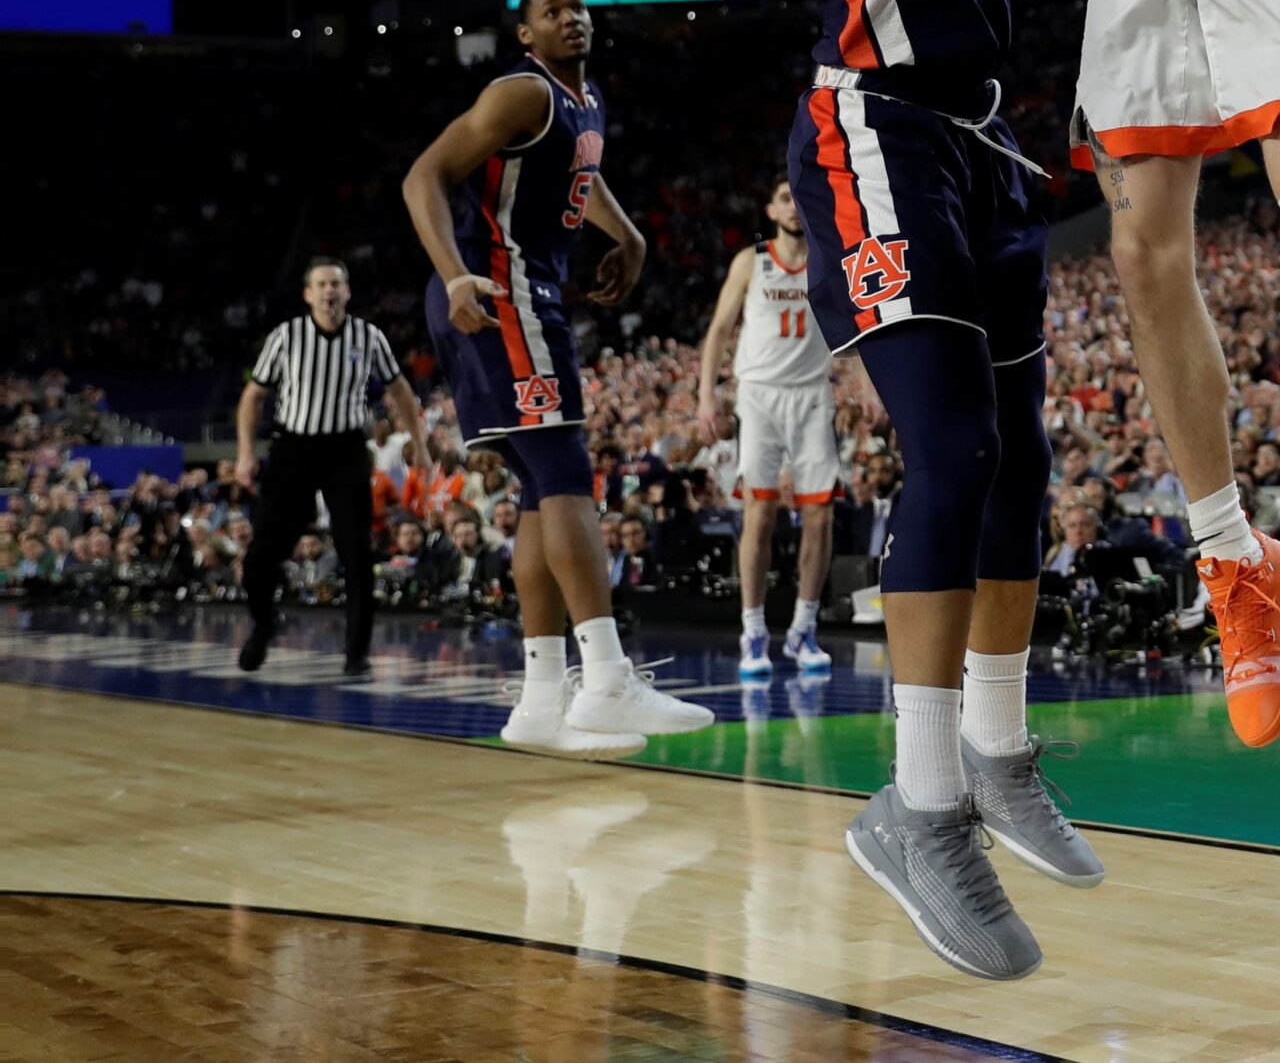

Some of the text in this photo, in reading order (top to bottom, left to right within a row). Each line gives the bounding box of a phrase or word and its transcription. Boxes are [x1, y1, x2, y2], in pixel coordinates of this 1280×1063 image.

[562, 171, 593, 229] 5
[763, 287, 810, 301] VIRGIN
[778, 306, 807, 339] 11
